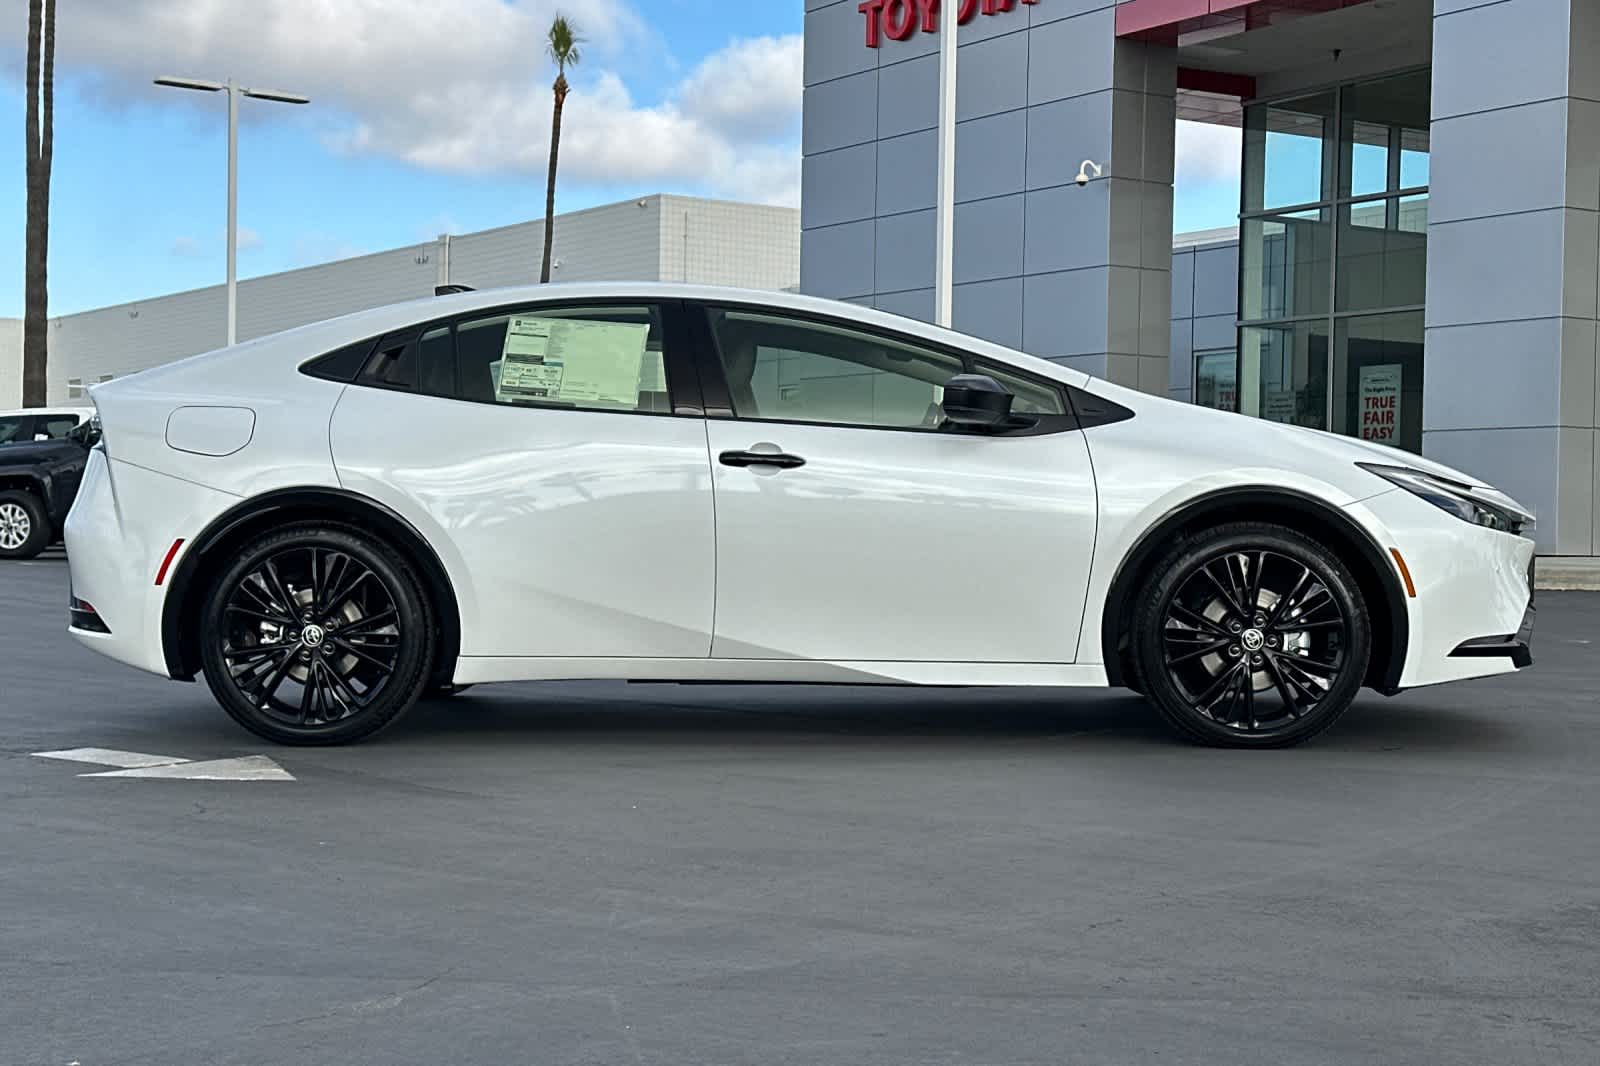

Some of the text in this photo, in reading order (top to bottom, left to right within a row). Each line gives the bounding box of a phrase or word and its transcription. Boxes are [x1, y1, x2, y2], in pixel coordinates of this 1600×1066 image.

[858, 0, 1040, 48] TOY
[1364, 395, 1396, 409] TRUE
[1363, 410, 1395, 425] FAIR
[1362, 426, 1395, 441] EASY
